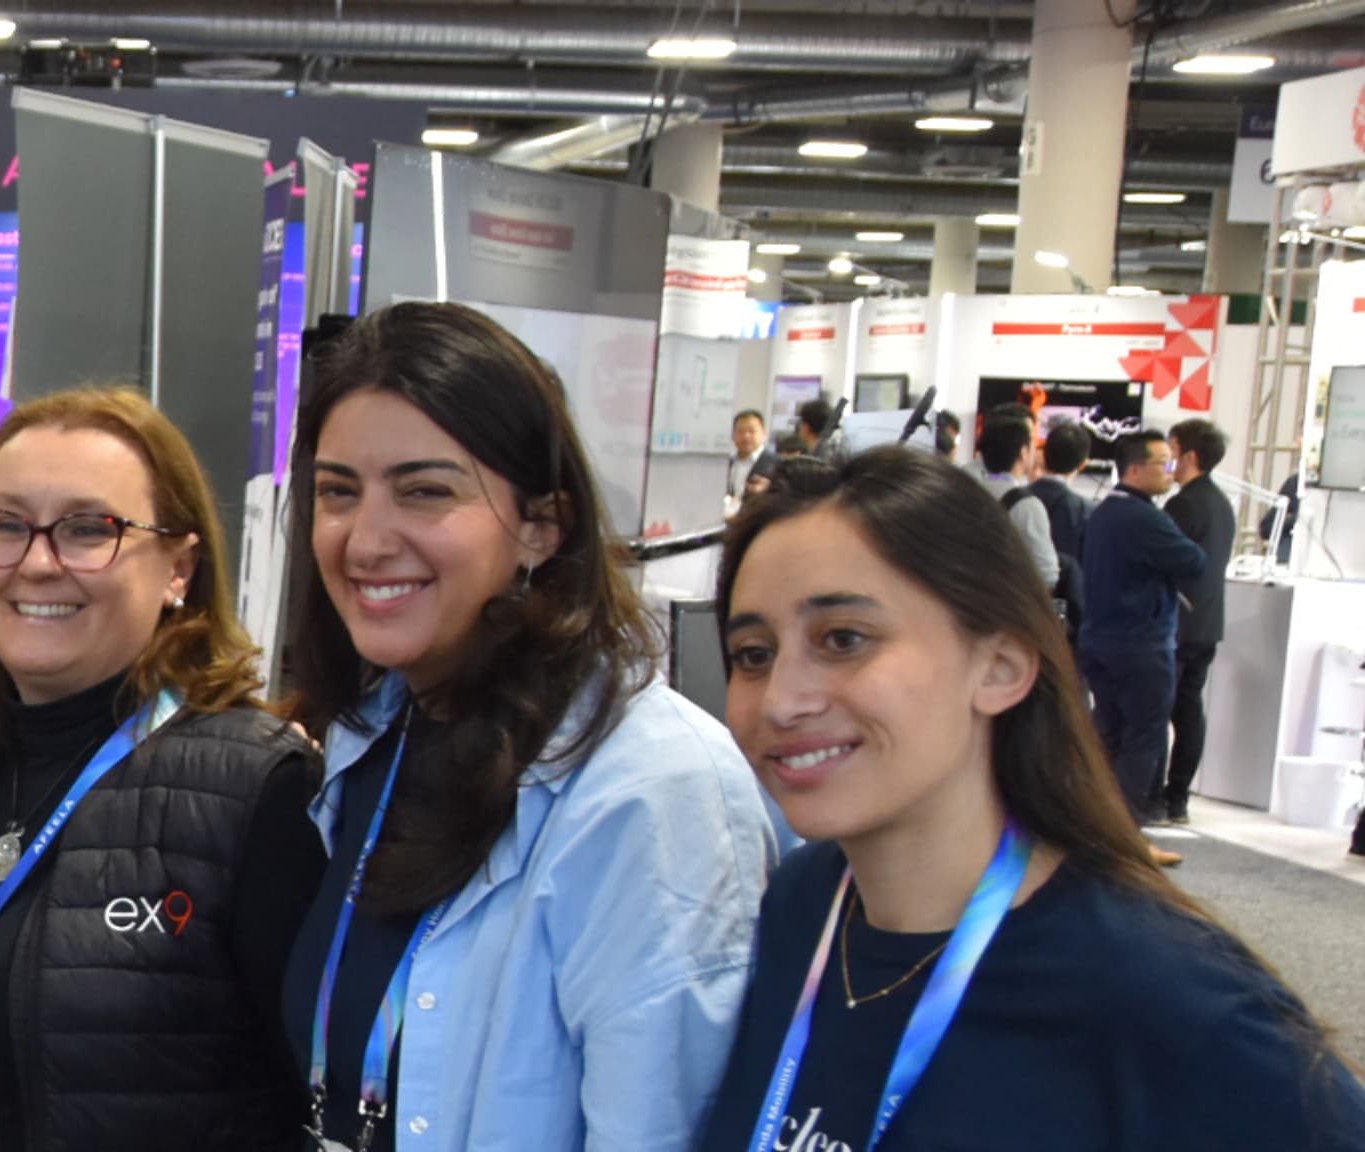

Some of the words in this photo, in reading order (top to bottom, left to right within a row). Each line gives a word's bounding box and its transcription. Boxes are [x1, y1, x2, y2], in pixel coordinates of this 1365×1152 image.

[34, 799, 75, 855] AFEELA
[103, 889, 194, 937] ex9
[767, 1055, 797, 1121] Mobility
